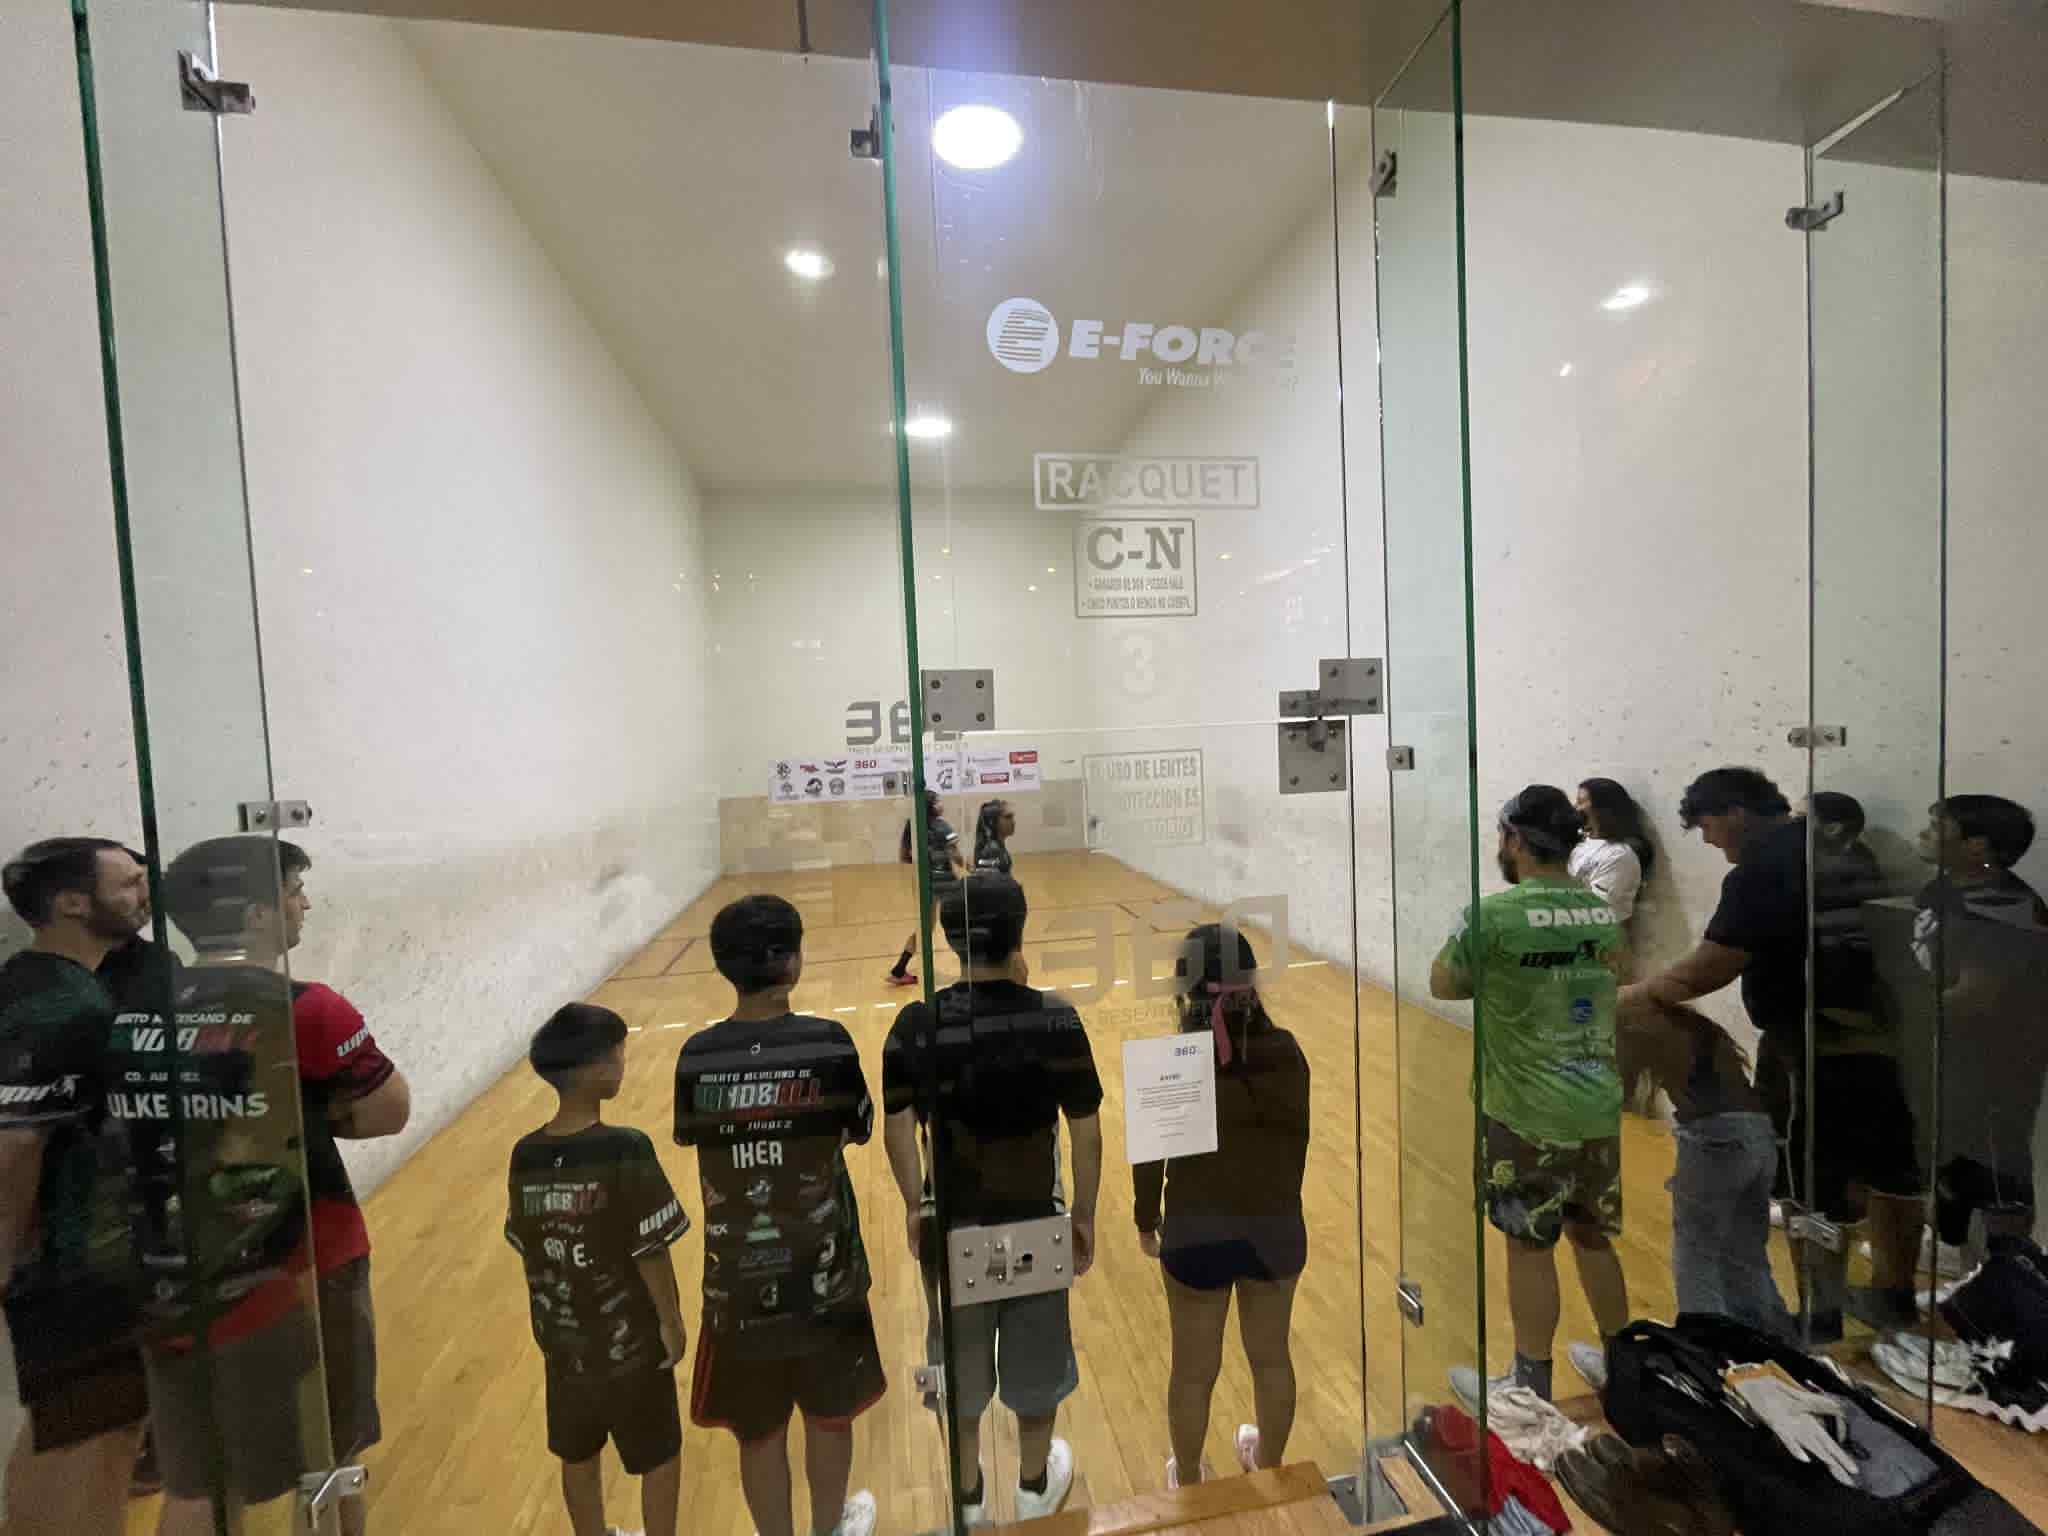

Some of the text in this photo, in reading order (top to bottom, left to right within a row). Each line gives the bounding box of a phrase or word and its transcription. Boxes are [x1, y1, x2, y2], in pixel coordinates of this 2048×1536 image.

[1087, 526, 1185, 570] C-N
[1135, 759, 1150, 780] DE
[1153, 756, 1197, 779] LENTES
